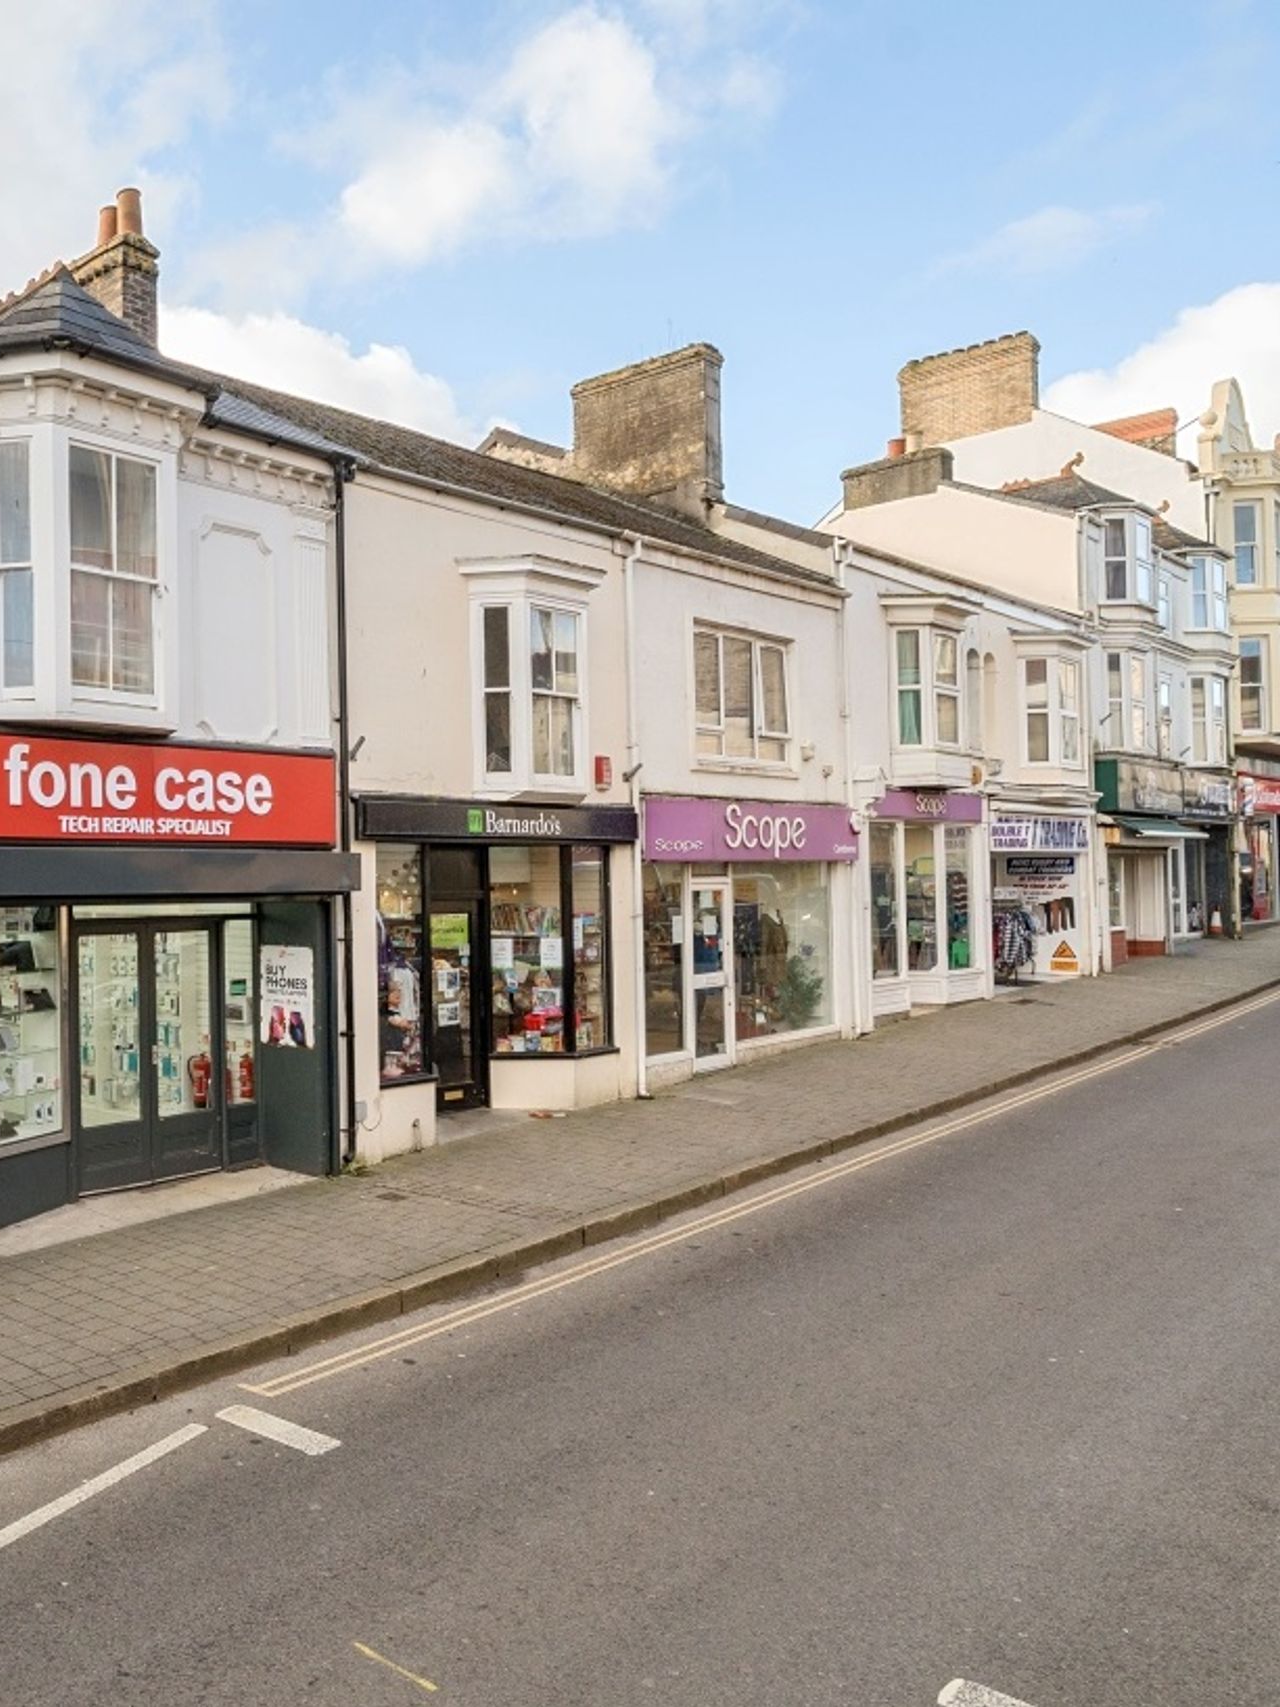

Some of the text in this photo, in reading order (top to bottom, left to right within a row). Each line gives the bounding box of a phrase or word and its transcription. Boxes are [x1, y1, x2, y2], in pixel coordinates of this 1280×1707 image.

[3, 743, 274, 816] fone case
[915, 793, 948, 817] Scope
[58, 814, 233, 838] TECH REPAIR SPECIALIST
[485, 809, 562, 835] Barnardo's
[723, 803, 807, 858] Scope
[654, 838, 704, 853] Scope
[265, 963, 287, 976] BUY
[265, 976, 308, 990] PHONES
